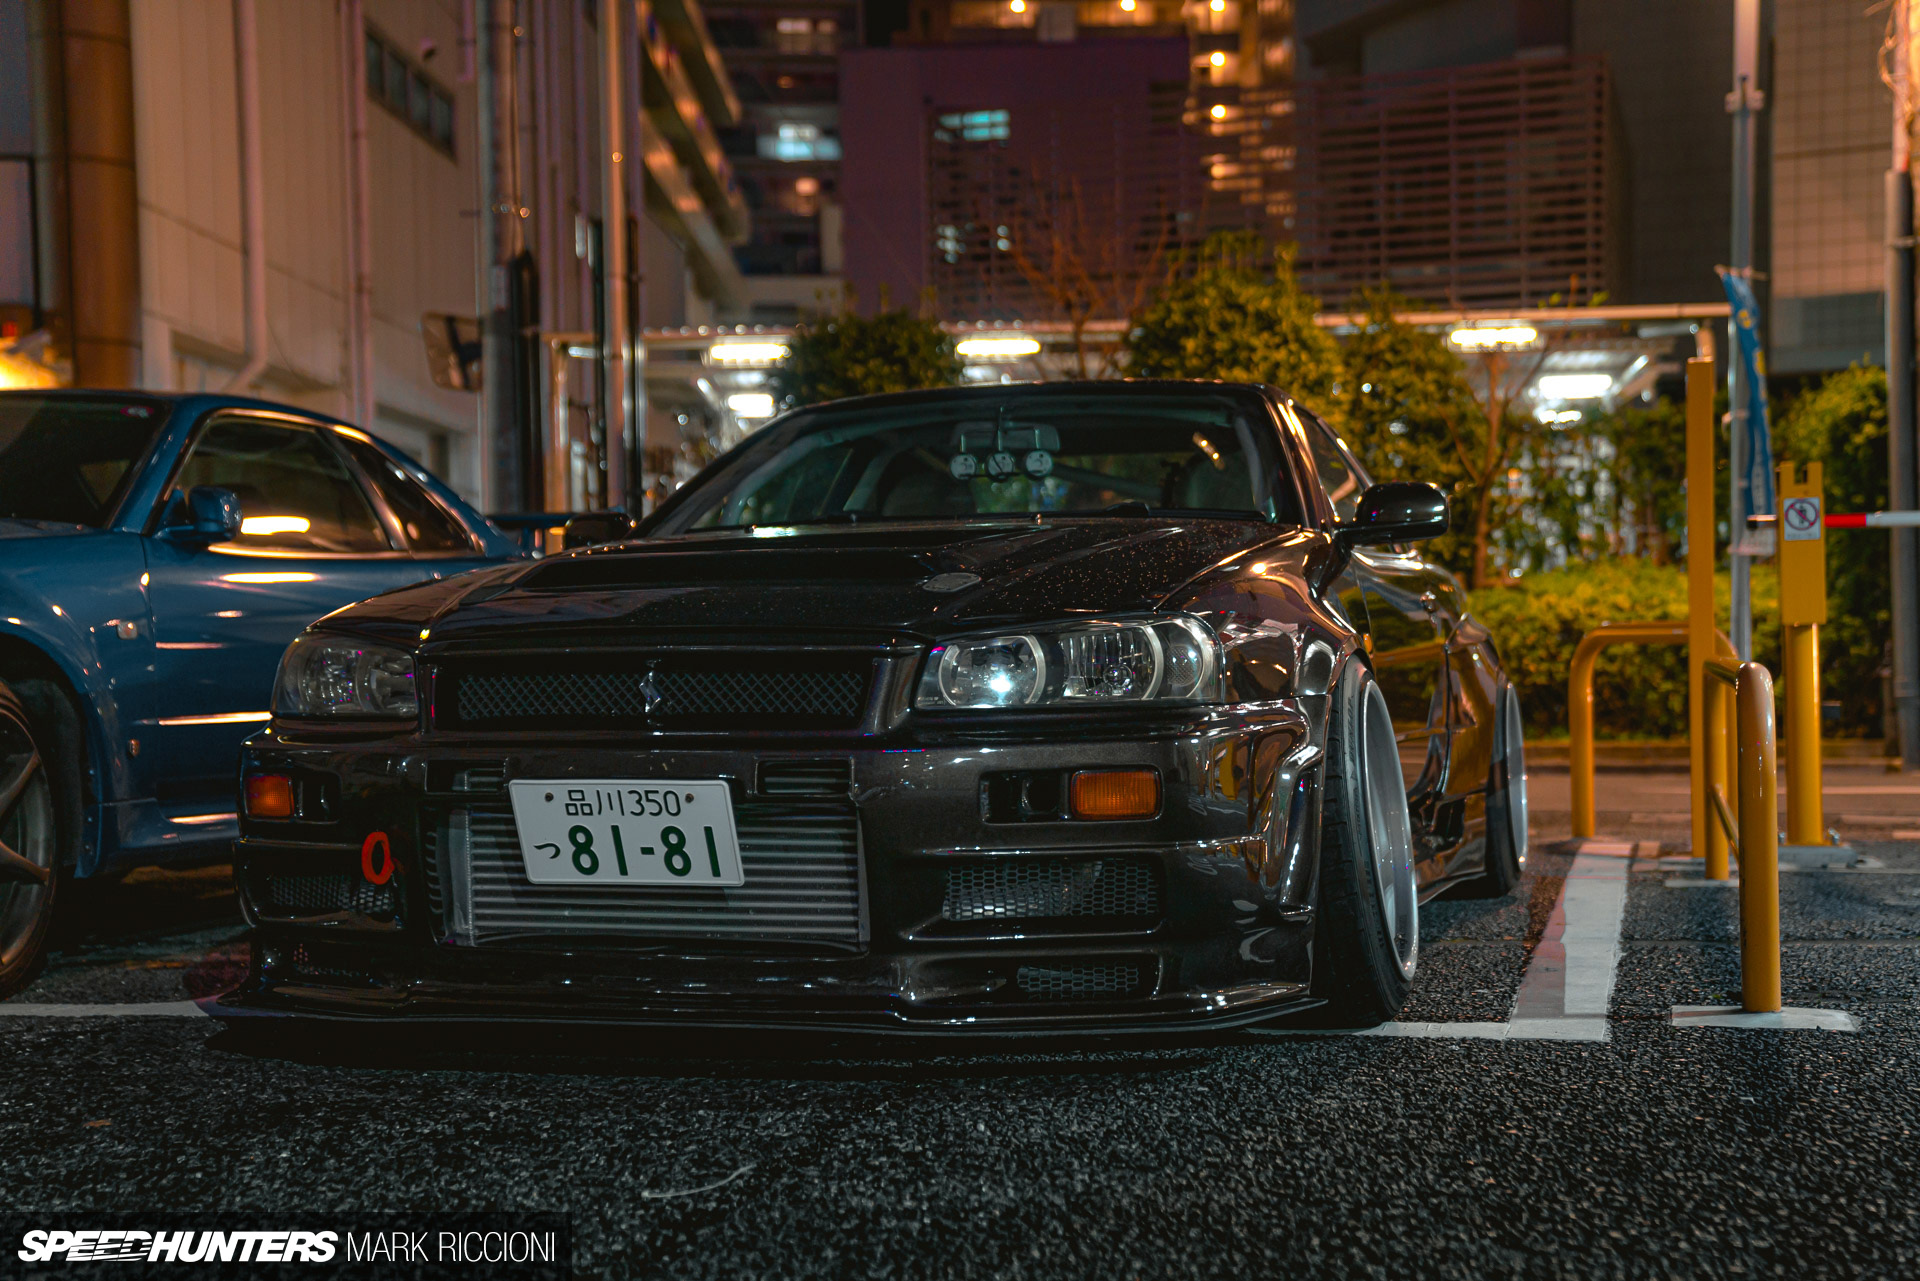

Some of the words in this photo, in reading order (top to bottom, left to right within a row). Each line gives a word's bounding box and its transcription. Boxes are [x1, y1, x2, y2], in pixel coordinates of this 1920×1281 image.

[564, 789, 682, 817] 品川350
[533, 842, 561, 859] つ
[568, 824, 722, 878] 81-81
